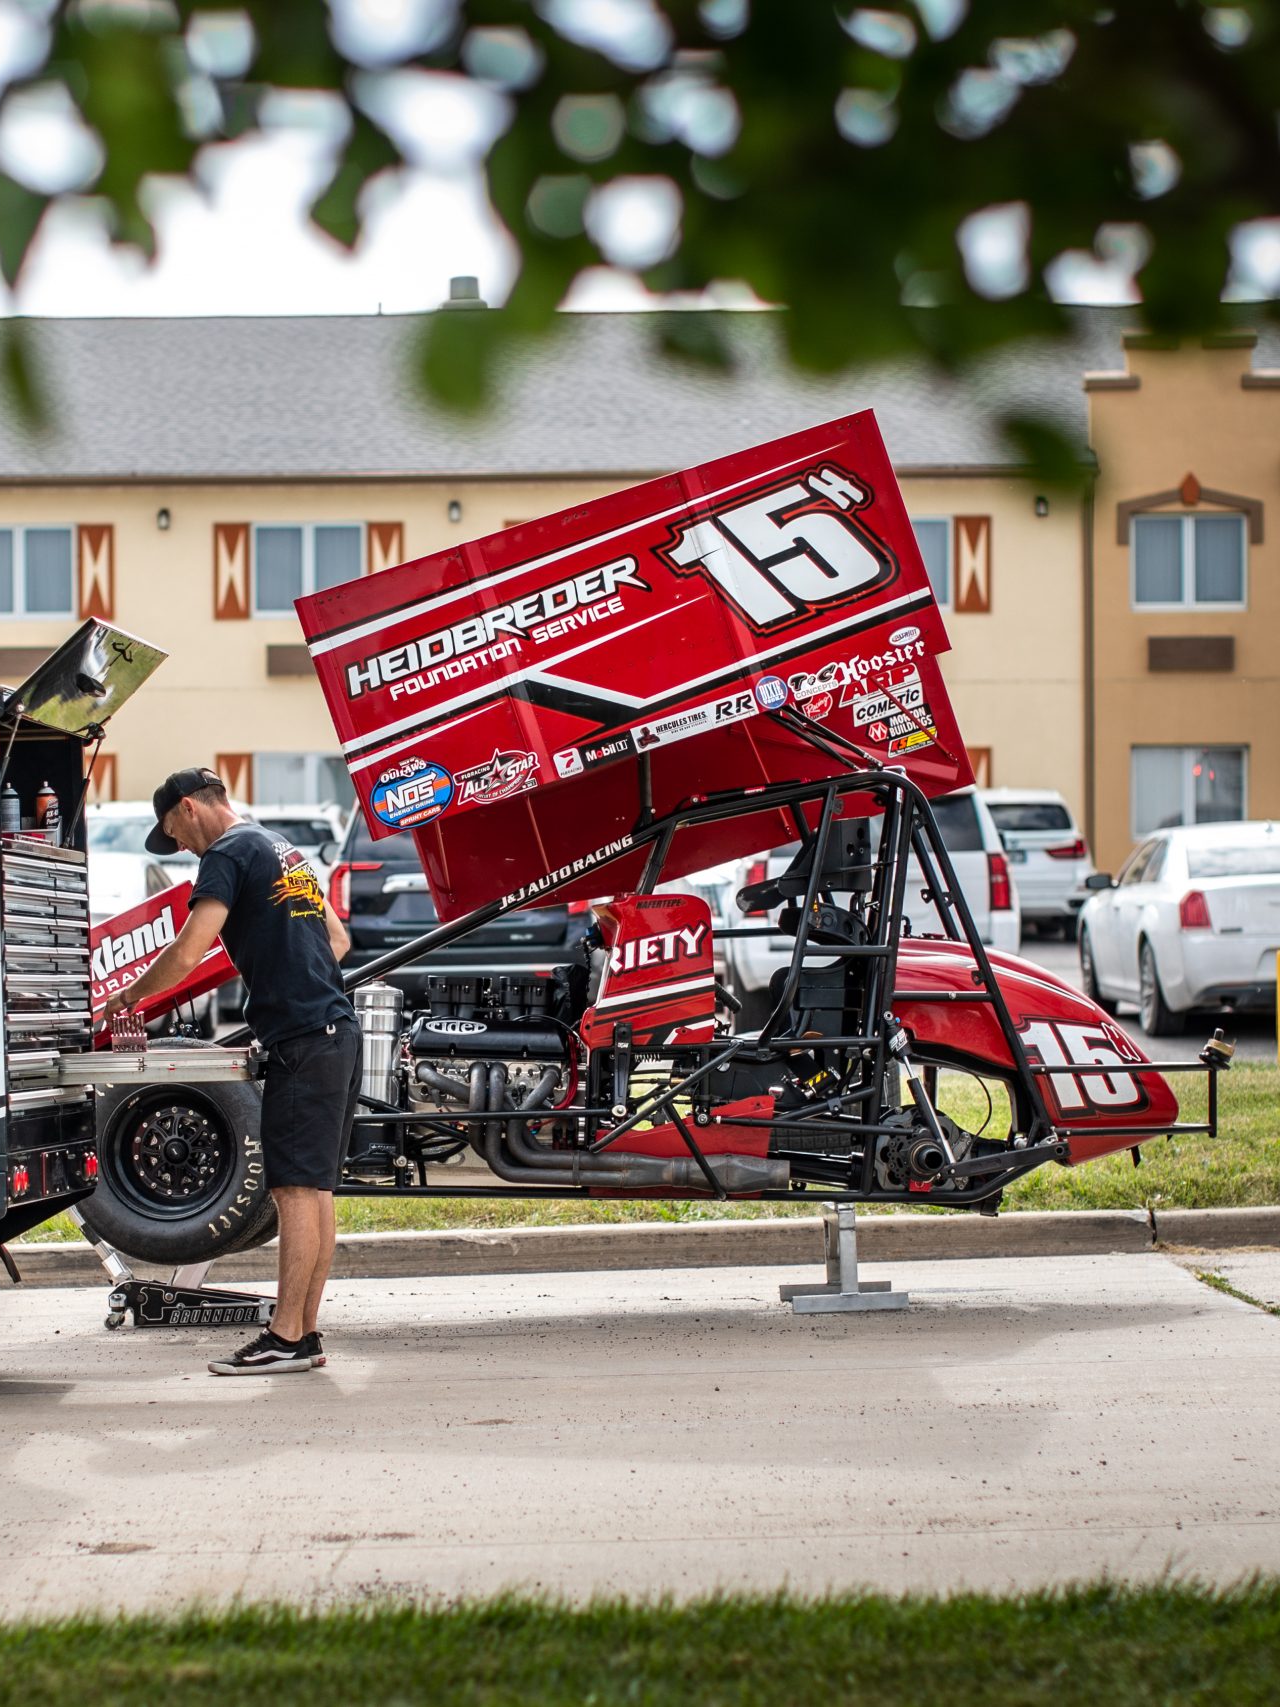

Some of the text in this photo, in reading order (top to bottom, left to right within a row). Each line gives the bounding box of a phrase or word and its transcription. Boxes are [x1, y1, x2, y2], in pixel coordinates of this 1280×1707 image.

[348, 557, 649, 698] HEIDBREDER
[389, 596, 625, 702] FOUNDATION SERVICE
[838, 640, 925, 682] Hoosier
[758, 679, 782, 700] DIXIE
[795, 681, 839, 699] CONCEPTS
[842, 664, 916, 702] ARP
[806, 696, 830, 717] Racing
[655, 716, 688, 734] HERCULES
[585, 742, 616, 762] Mobil
[380, 758, 427, 784] OUTLAWS
[460, 766, 491, 781] FLORACING
[463, 755, 535, 799] ALL STAR
[385, 777, 435, 813] NOS
[389, 798, 435, 819] ENERGY DRINK
[400, 806, 441, 826] SPRINT CARS
[499, 834, 634, 911] J&J AUTO RACING
[636, 898, 683, 910] HAFERTEPE
